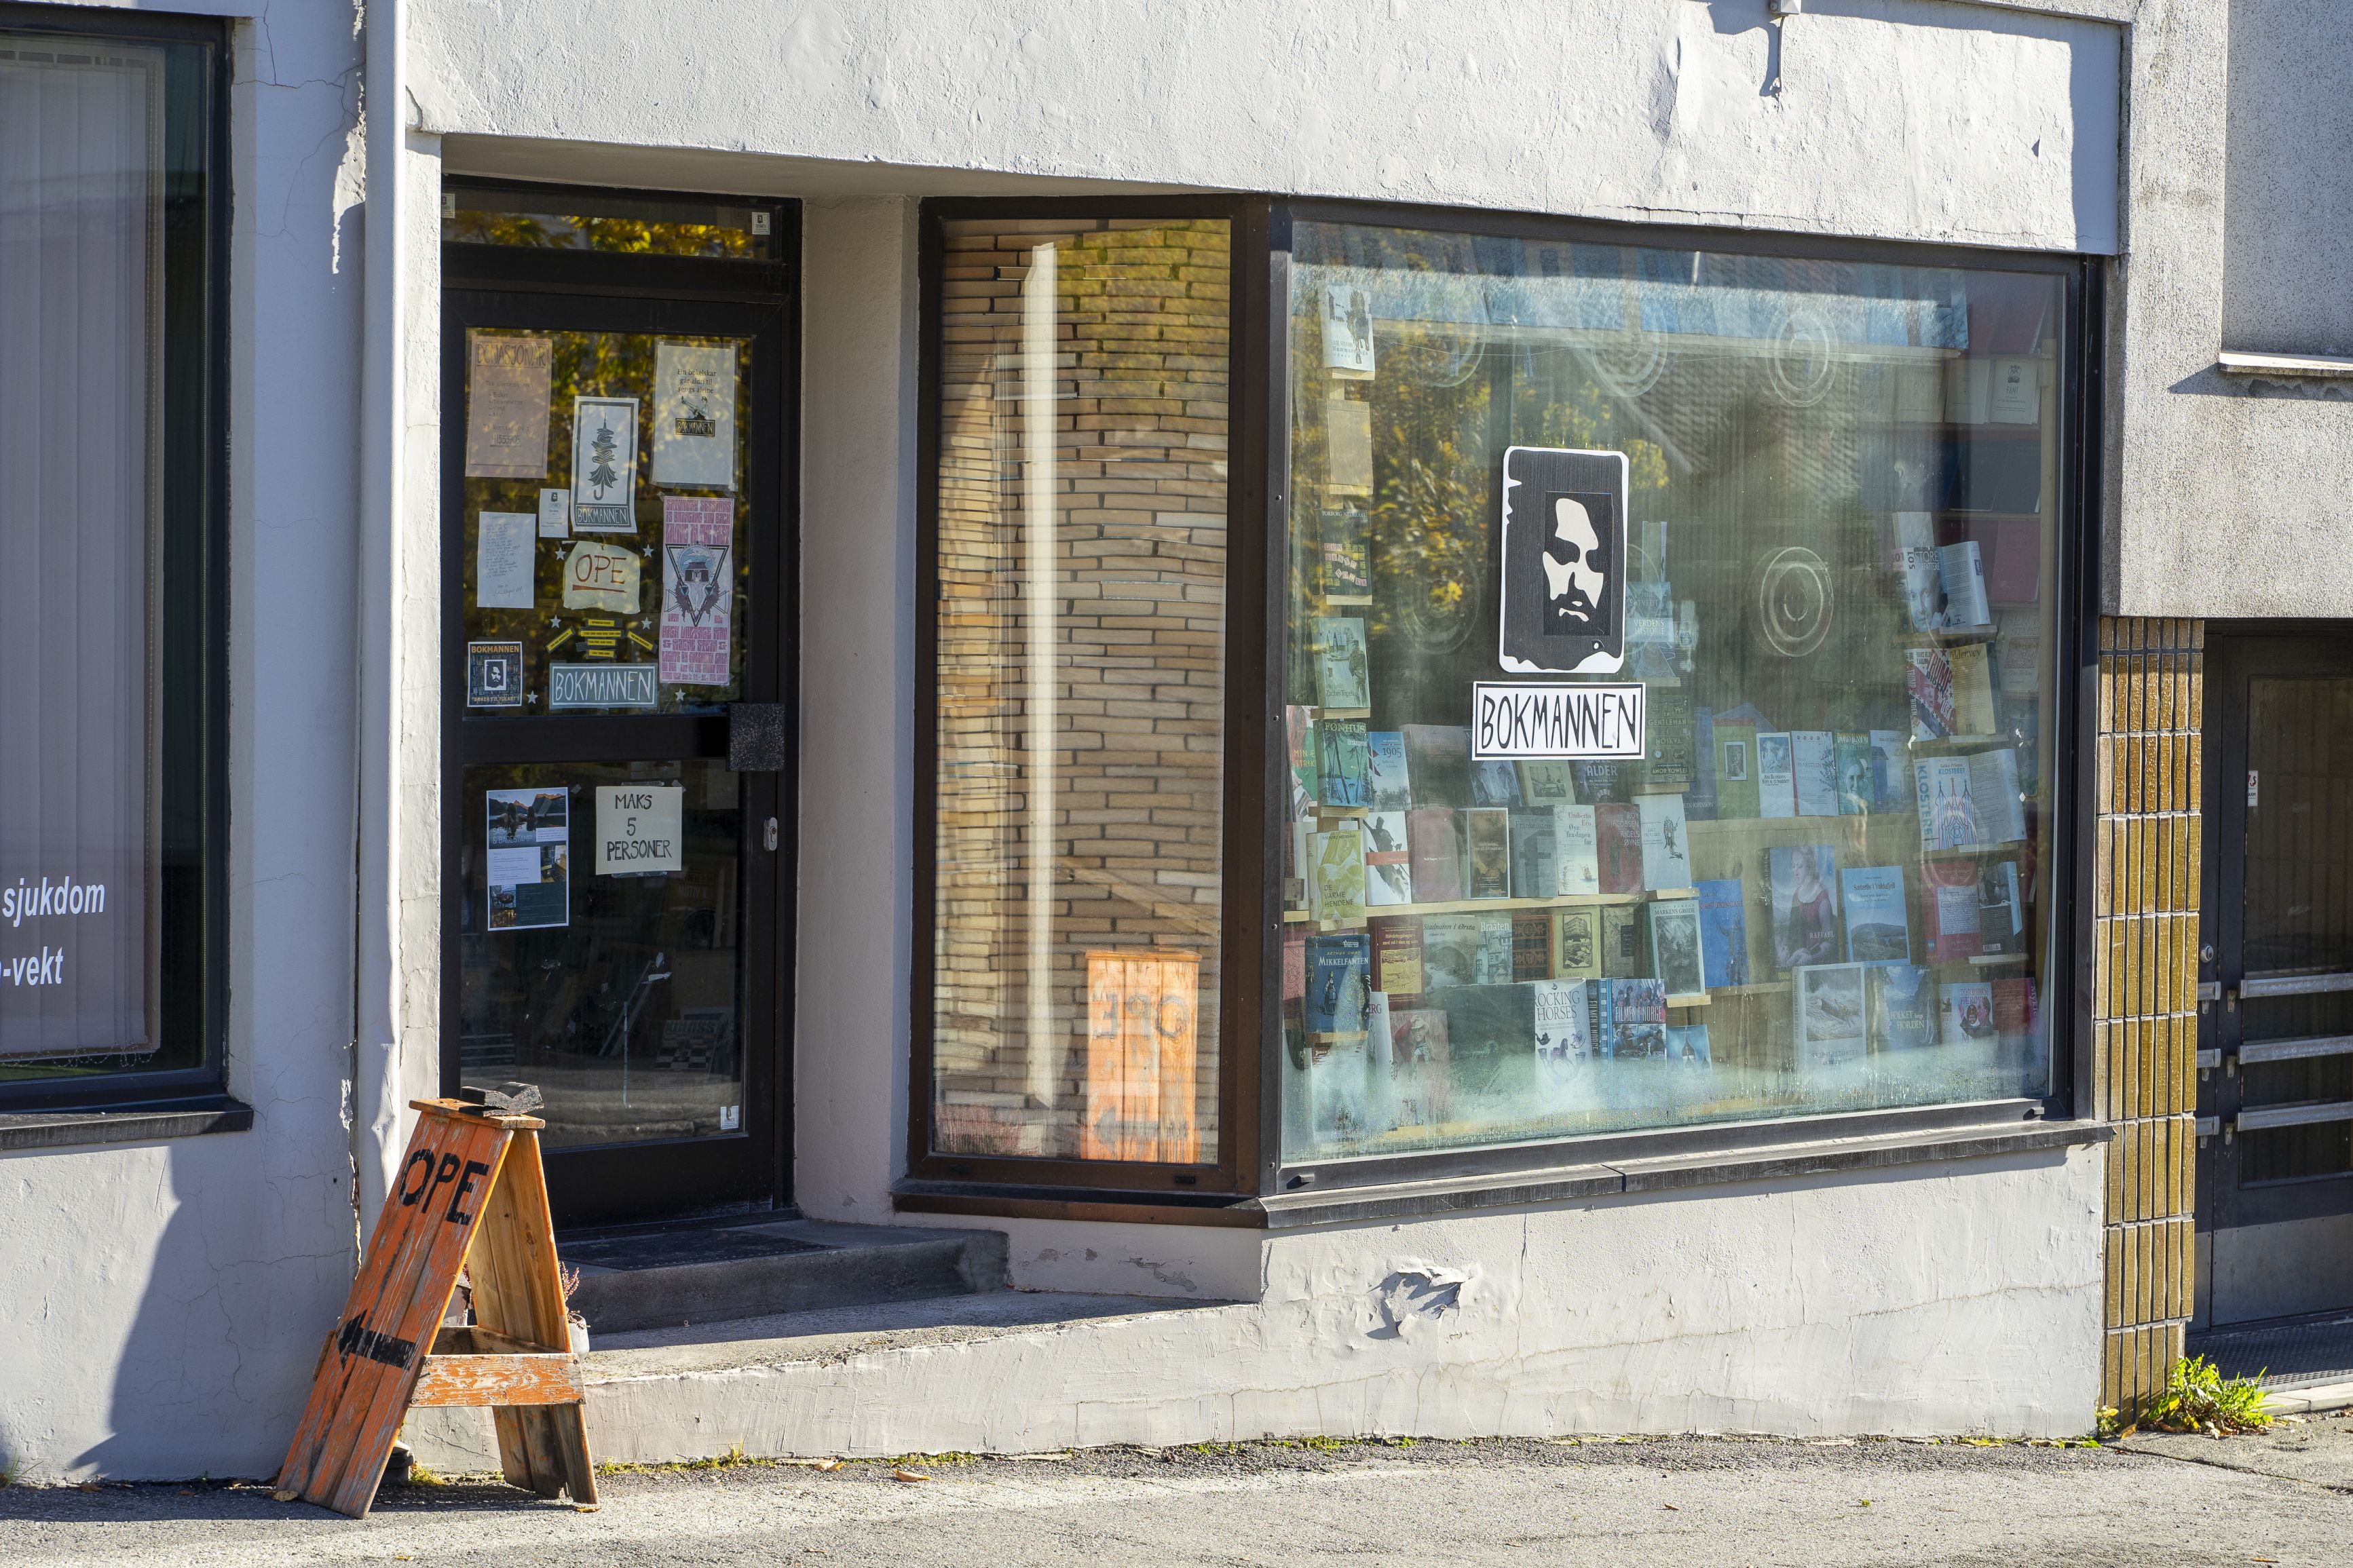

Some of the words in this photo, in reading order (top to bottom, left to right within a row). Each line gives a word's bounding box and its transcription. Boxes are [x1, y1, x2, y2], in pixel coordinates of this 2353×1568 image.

[477, 343, 546, 366] DONASJONAR
[677, 421, 713, 434] BOKMANNEN
[578, 508, 628, 524] BOKMANNEN
[1915, 550, 1939, 562] STORE
[576, 554, 626, 584] OPE
[1634, 618, 1665, 627] VERDENS
[1635, 627, 1665, 636] HISTORIE
[471, 645, 519, 653] BOKMANNEN
[1950, 649, 1981, 660] ildenvey
[1928, 649, 1953, 693] TRUMP
[555, 670, 652, 701] BOKMANNEN
[1482, 693, 1636, 749] BOKMANNEN
[1325, 722, 1367, 733] FØNHUS
[1294, 749, 1307, 757] MIN
[1382, 748, 1403, 759] 1905
[1587, 765, 1618, 776] ALDER
[1938, 767, 1965, 776] KLOSTERET
[616, 794, 653, 809] MAKS
[627, 817, 637, 836] 5
[1610, 820, 1640, 828] JACOBSEN
[499, 835, 532, 844] BADESTAMP
[1624, 838, 1640, 847] ØYNE
[607, 839, 672, 861] PERSONER
[678, 885, 699, 898] MOTIV
[1325, 892, 1345, 900] VARME
[2, 876, 105, 928] sjukdom
[1325, 899, 1354, 908] HENDENE
[1481, 922, 1509, 932] Braaten
[1809, 931, 1834, 939] RAFFAEL
[0, 946, 64, 986] -vekt
[1319, 957, 1368, 966] MIKKELFANTEN
[1960, 988, 1989, 996] TORBJØRN
[1534, 991, 1580, 1007] ROCKING
[1537, 1005, 1577, 1021] HORSES
[1615, 1006, 1636, 1022] FILMEN
[1643, 1006, 1662, 1021] NORGE
[1890, 1010, 1913, 1020] FOLKET
[1897, 1020, 1925, 1031] FJORDEN
[398, 1148, 489, 1226] OPE
